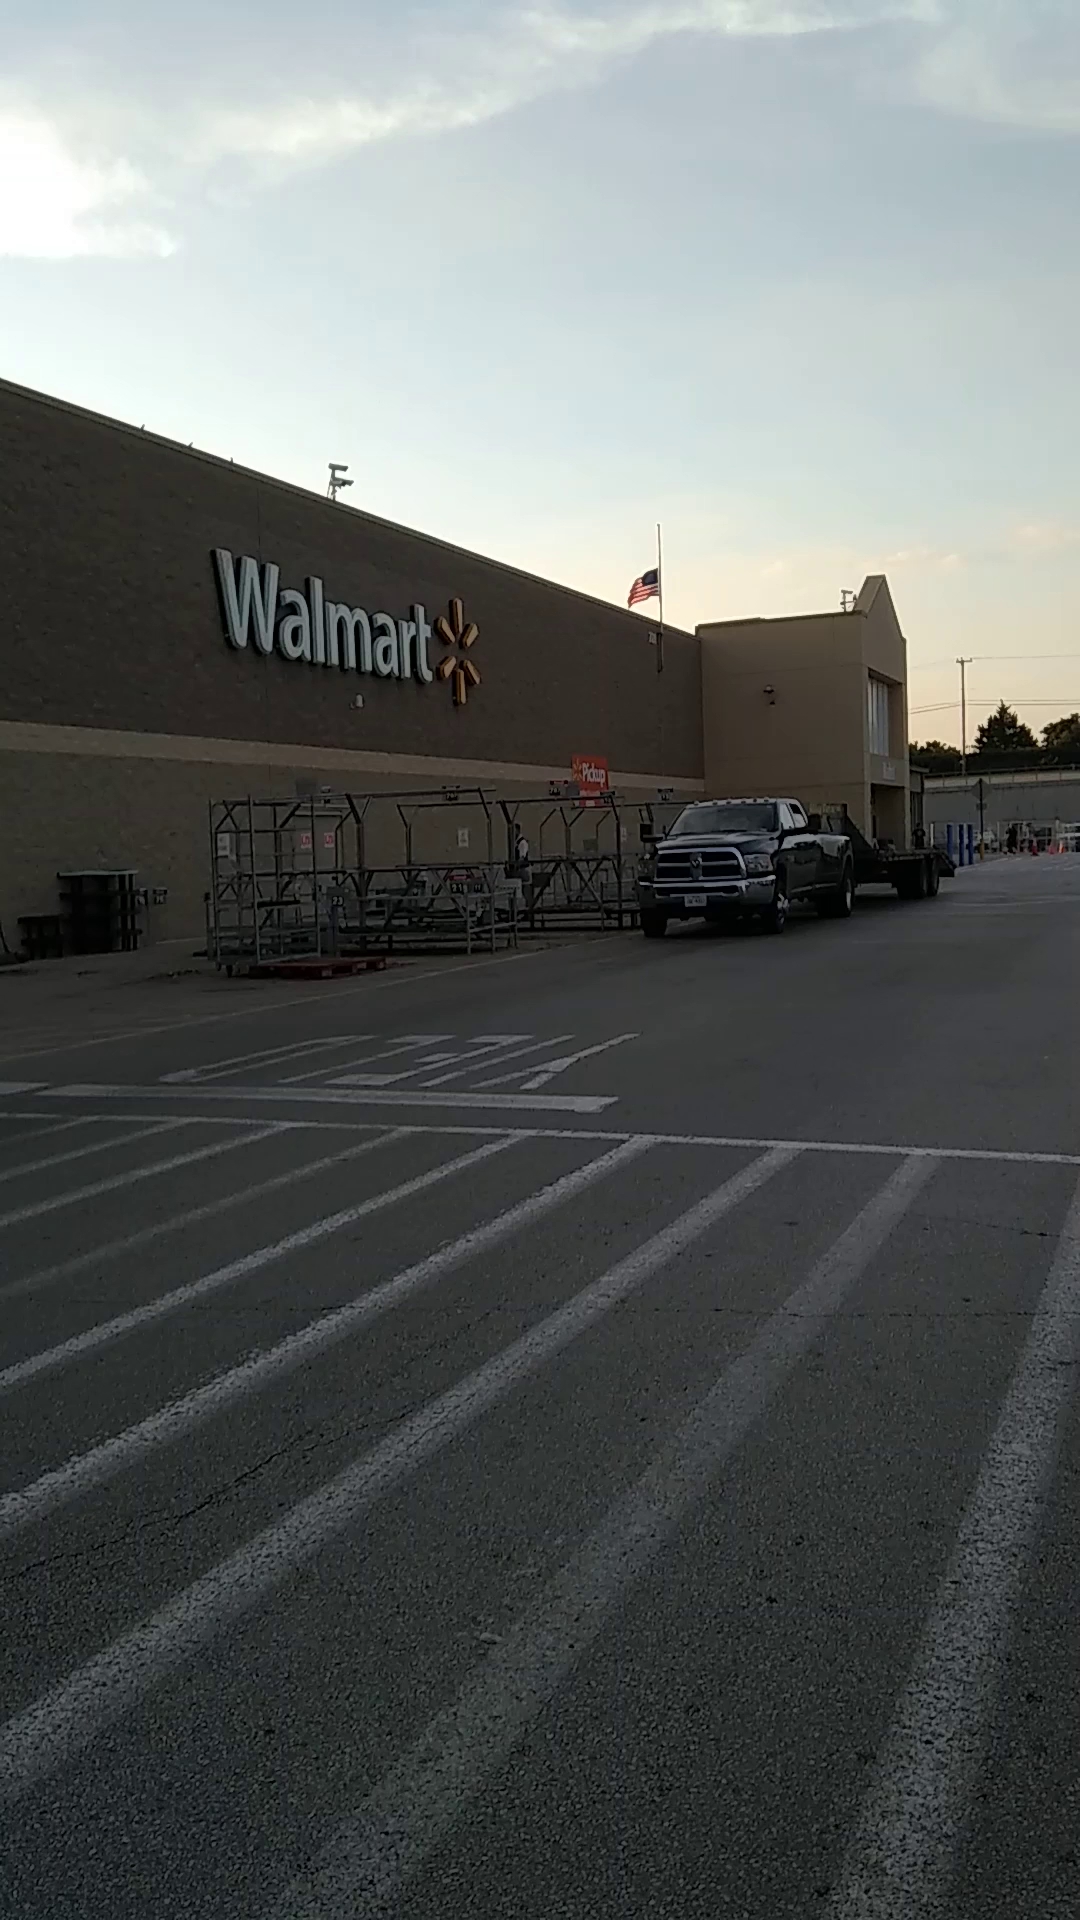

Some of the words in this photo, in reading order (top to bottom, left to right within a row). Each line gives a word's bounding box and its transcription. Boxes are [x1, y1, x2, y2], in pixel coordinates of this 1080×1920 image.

[211, 547, 433, 684] Walmart
[582, 762, 606, 788] Pickup
[159, 1033, 641, 1091] YIELD
